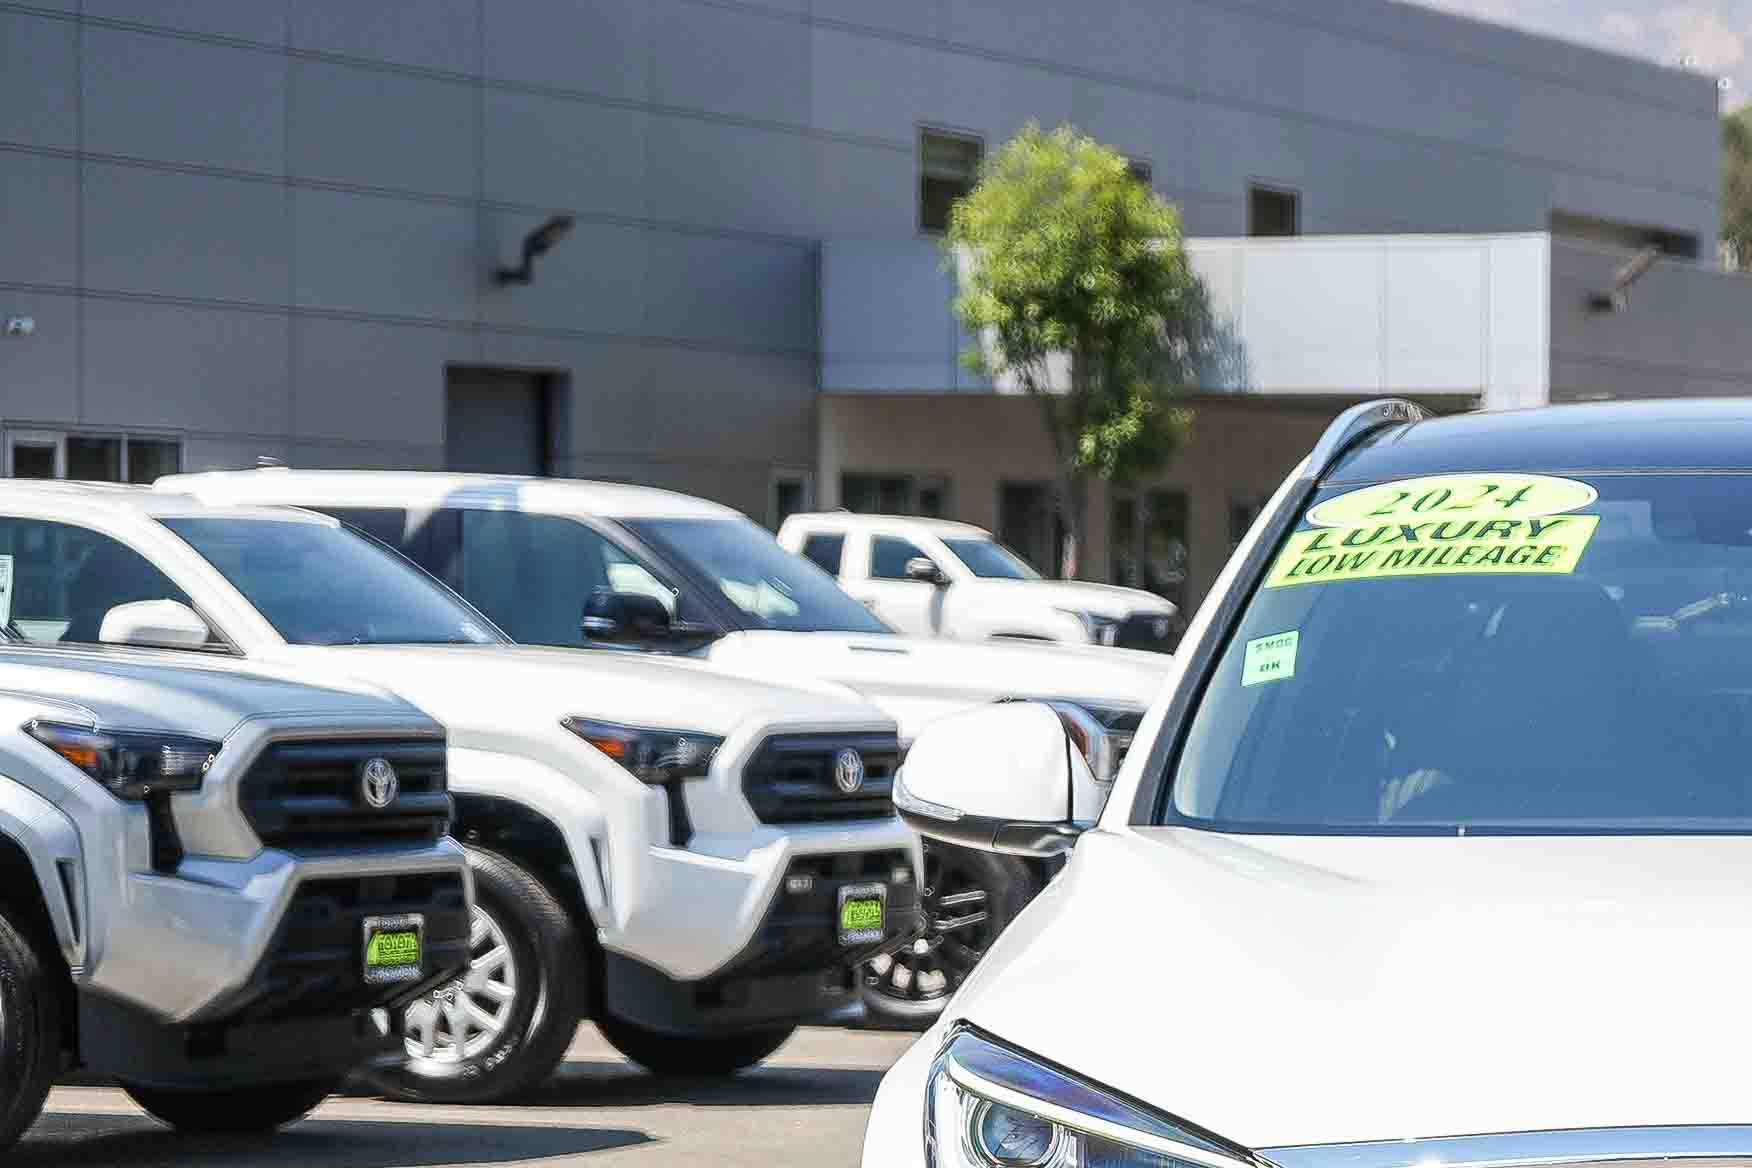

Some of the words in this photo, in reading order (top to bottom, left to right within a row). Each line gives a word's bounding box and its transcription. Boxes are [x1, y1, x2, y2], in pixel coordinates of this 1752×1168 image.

[1364, 484, 1535, 517] 2024
[1301, 519, 1569, 553] LUXURY
[1284, 549, 1378, 578] LOW
[1378, 545, 1562, 570] MILEAGE
